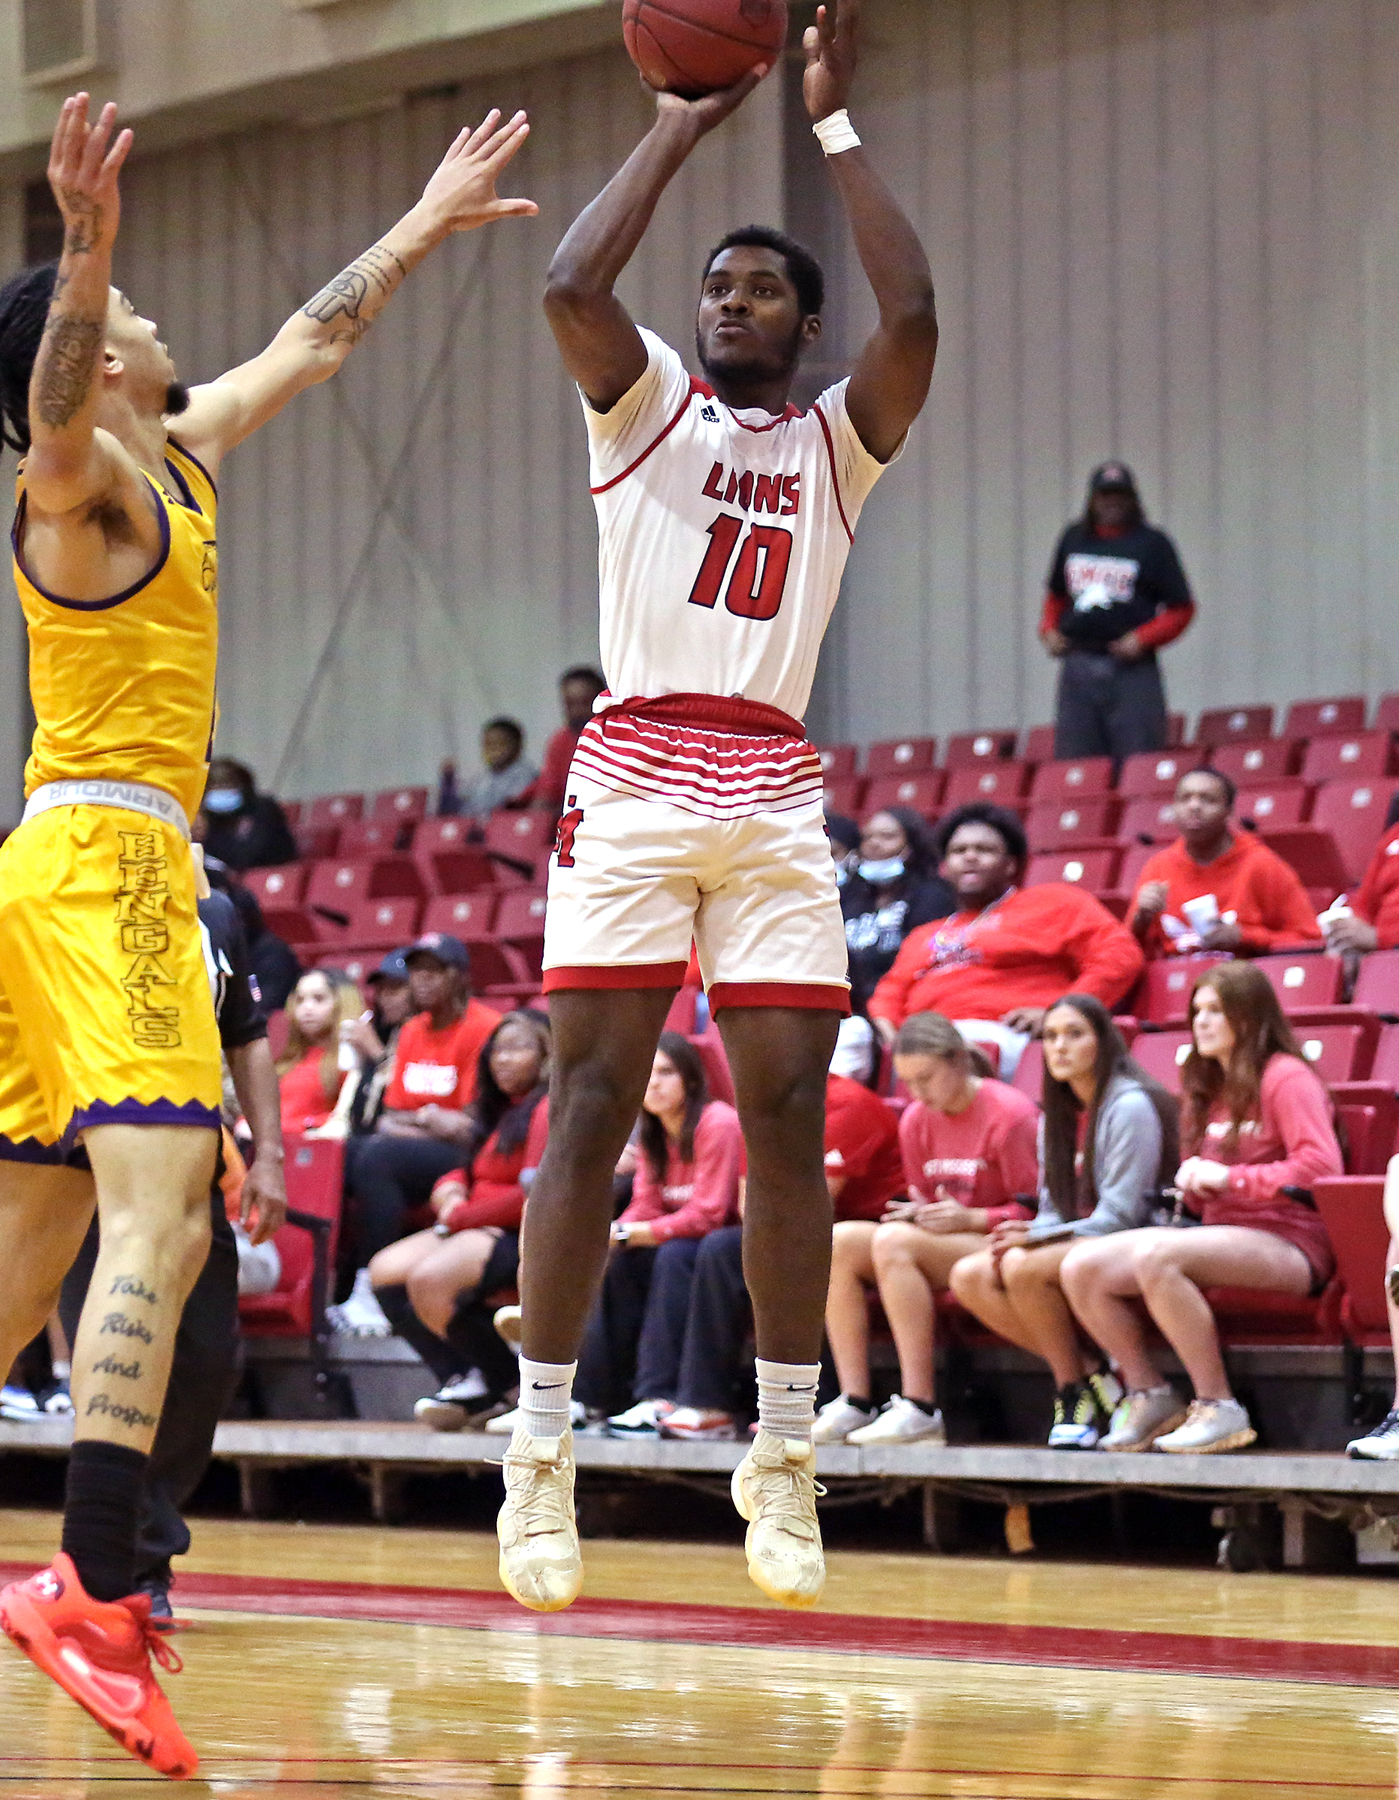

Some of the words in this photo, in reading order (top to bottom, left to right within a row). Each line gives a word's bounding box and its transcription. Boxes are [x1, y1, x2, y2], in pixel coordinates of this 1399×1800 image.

[702, 460, 800, 516] LIONS
[687, 512, 793, 621] 10
[113, 829, 181, 1049] BENGALS
[110, 1275, 157, 1304] Take
[92, 1354, 142, 1380] And
